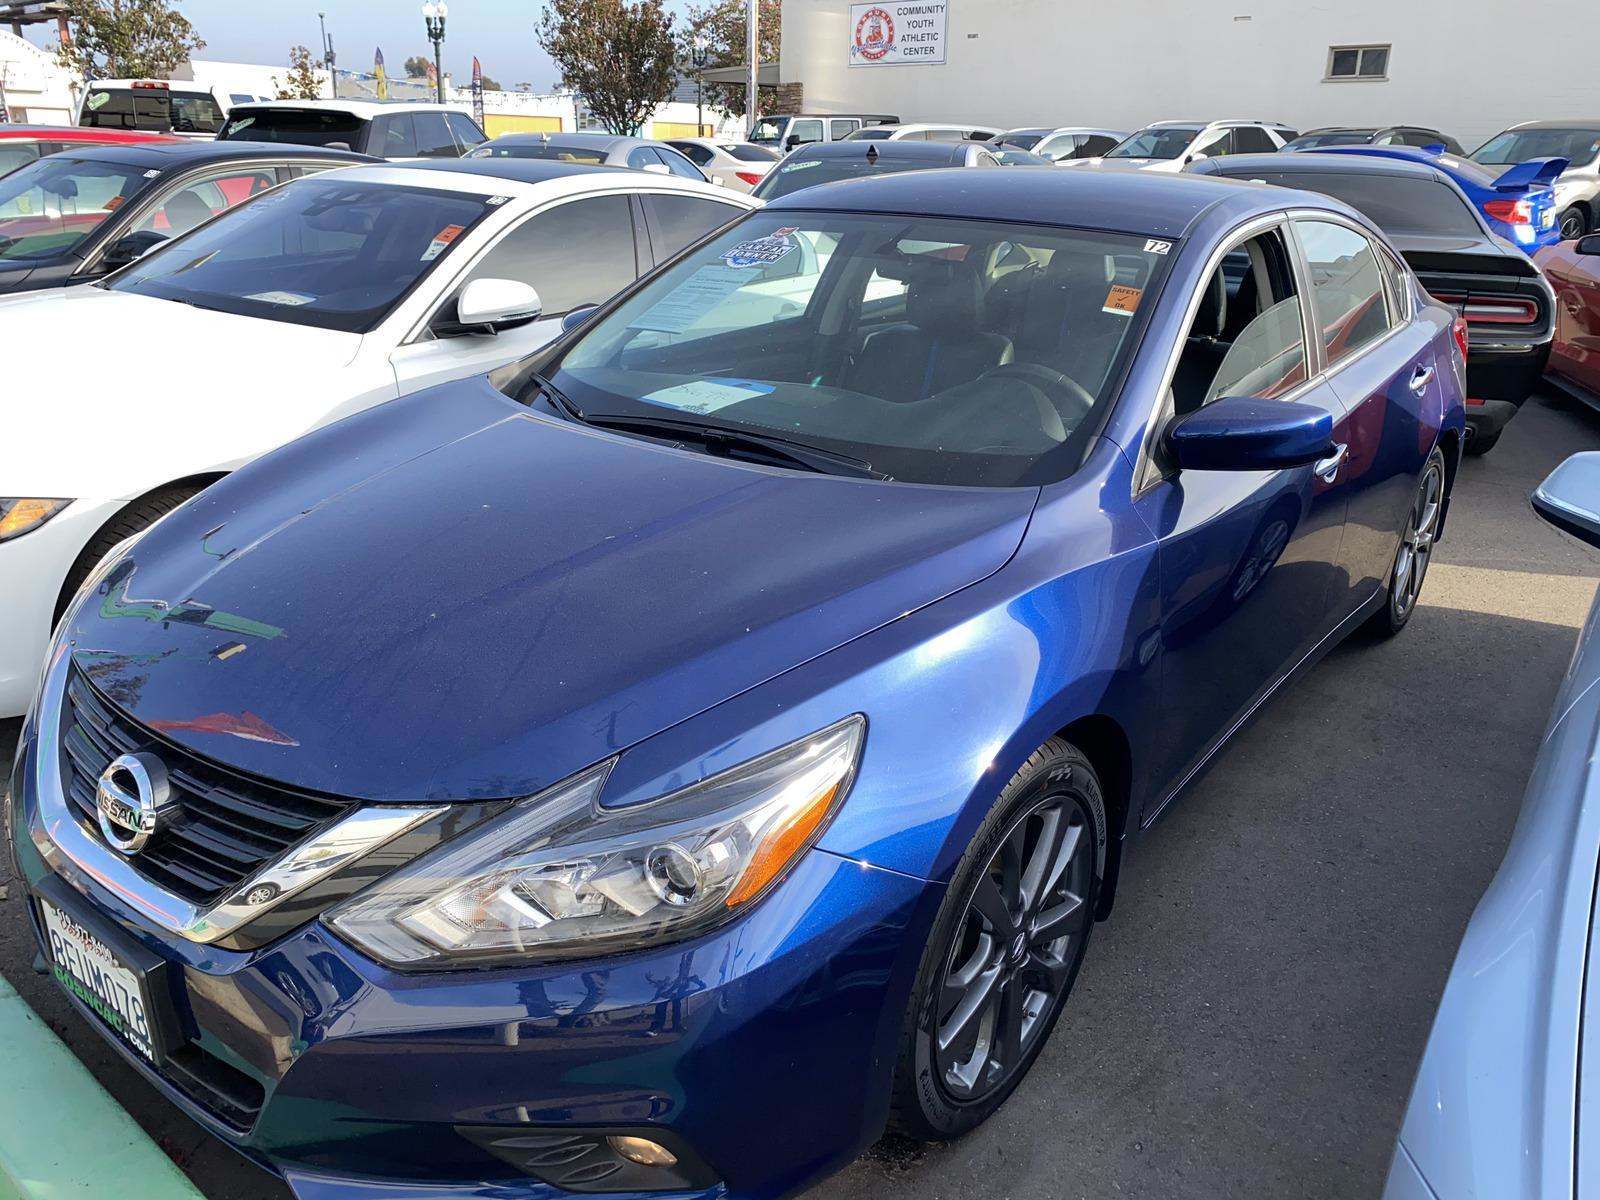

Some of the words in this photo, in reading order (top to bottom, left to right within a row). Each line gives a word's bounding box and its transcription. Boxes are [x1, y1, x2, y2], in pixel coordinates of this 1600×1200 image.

[896, 4, 945, 16] COMMUNITY
[906, 19, 934, 29] YOUTH
[900, 32, 939, 42] ATHLETIC
[902, 46, 935, 56] CENTER
[1148, 240, 1169, 254] 72
